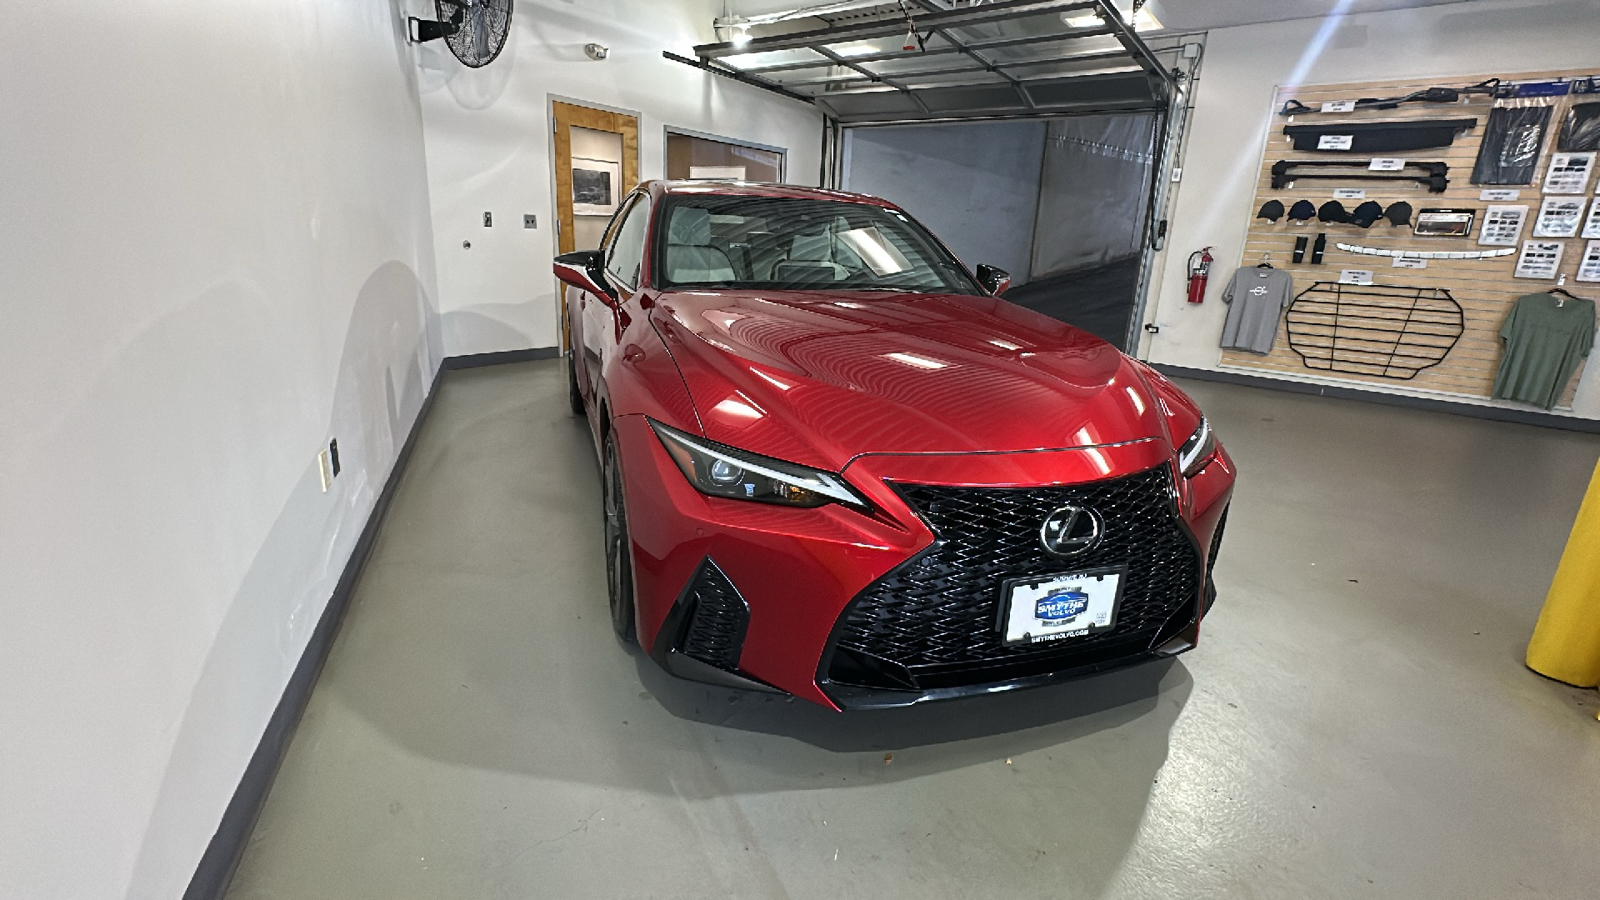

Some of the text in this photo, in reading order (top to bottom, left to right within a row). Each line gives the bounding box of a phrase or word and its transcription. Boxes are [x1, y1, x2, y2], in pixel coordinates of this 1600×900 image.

[1037, 601, 1084, 614] SMYTHE
[1047, 608, 1076, 617] VOLVO
[1031, 629, 1089, 643] SMYTHEVOLVO.COM
